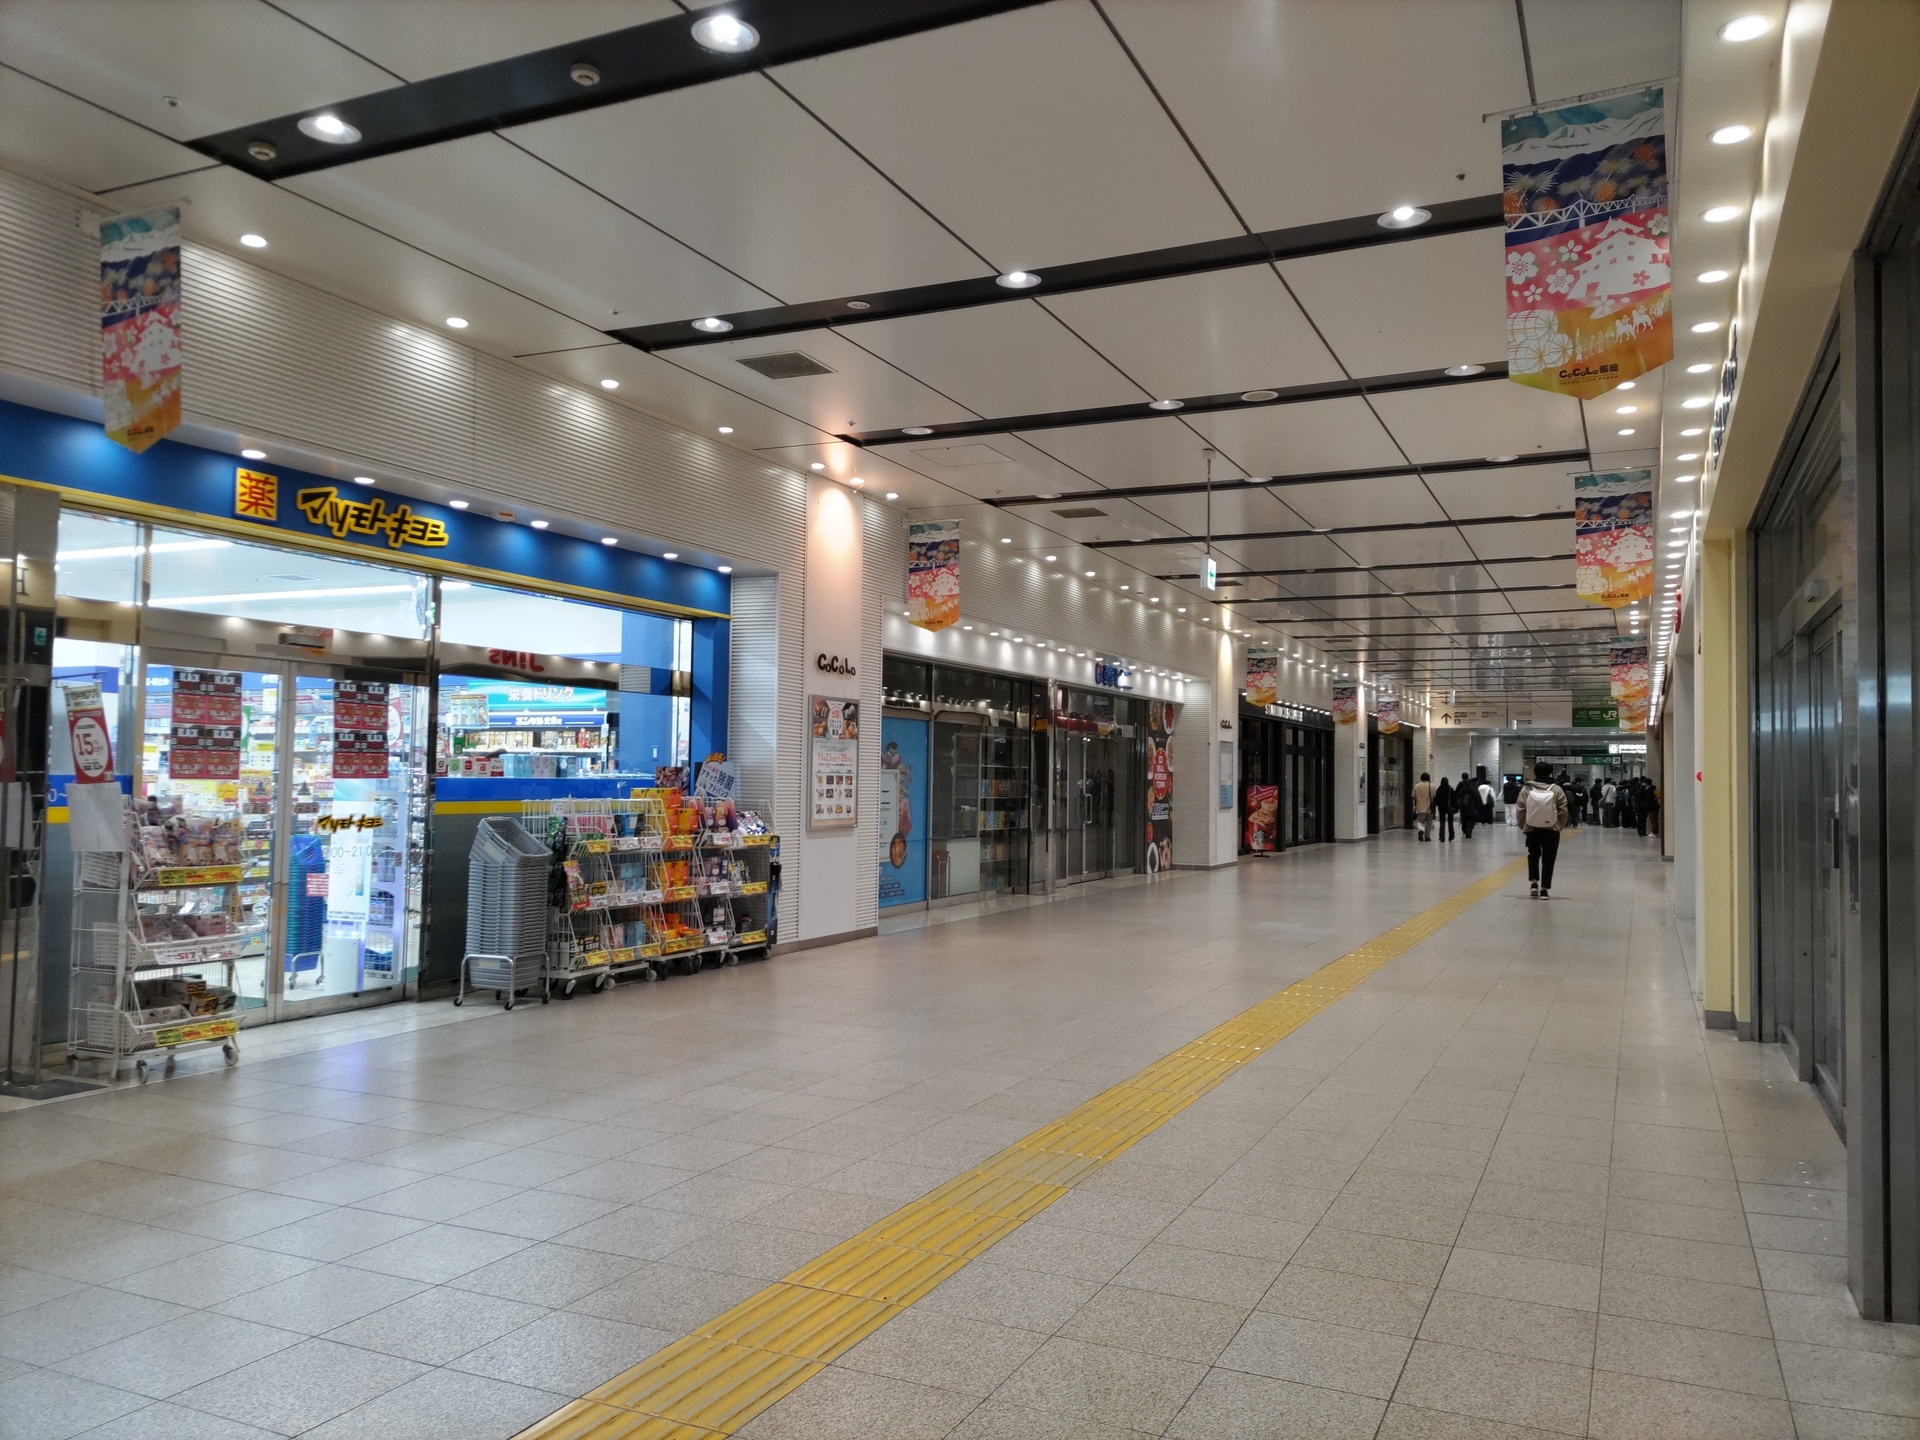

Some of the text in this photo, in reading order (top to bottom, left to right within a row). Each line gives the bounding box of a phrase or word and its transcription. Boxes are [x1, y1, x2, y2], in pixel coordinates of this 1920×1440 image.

[239, 471, 449, 547] 薬 マツモトキヨシ
[508, 687, 575, 702] 栄養ドリンク
[1603, 710, 1617, 718] JR
[76, 732, 94, 756] 15
[317, 814, 383, 834] マツモトキヨシ
